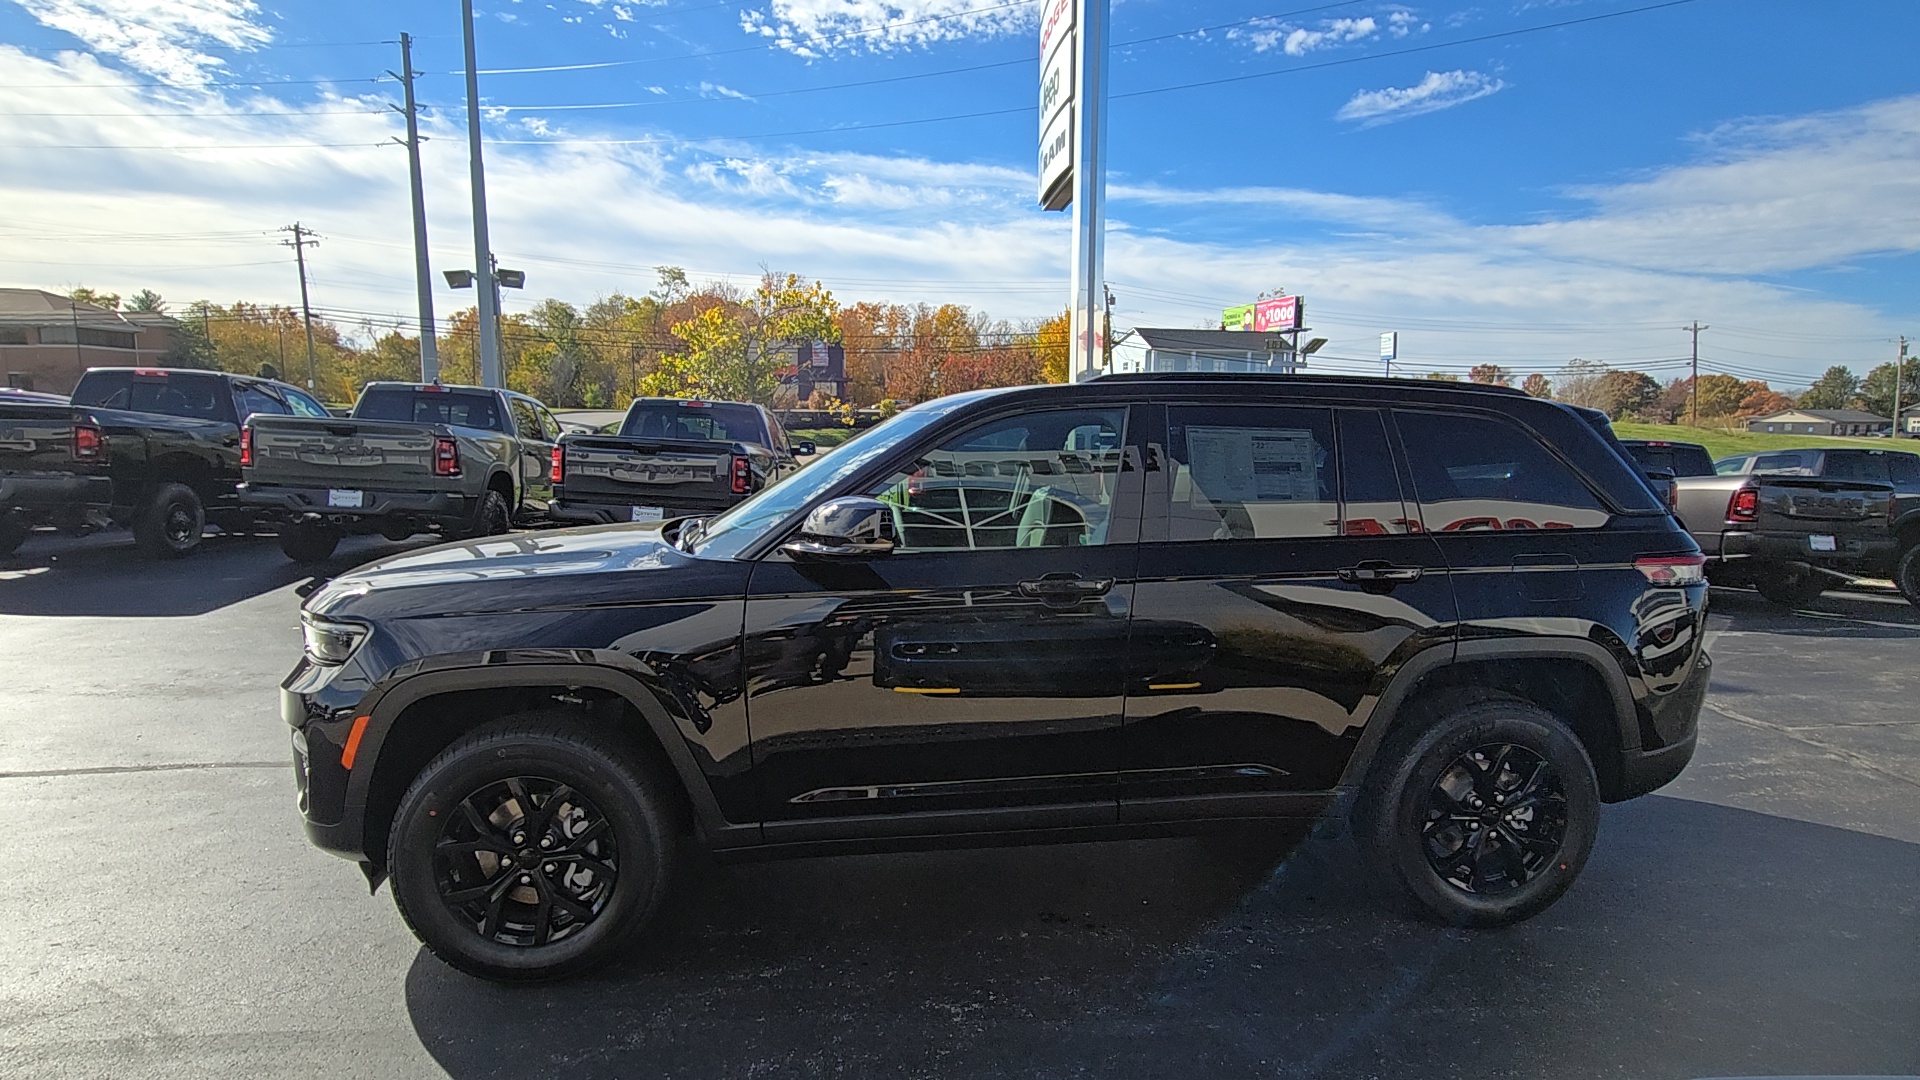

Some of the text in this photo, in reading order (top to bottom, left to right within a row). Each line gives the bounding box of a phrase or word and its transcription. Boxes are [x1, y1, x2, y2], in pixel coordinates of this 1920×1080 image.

[1041, 67, 1060, 119] Jeep
[1043, 129, 1066, 173] RAM
[1265, 305, 1294, 323] $1000
[299, 443, 383, 456] RAM
[609, 463, 685, 474] RAM
